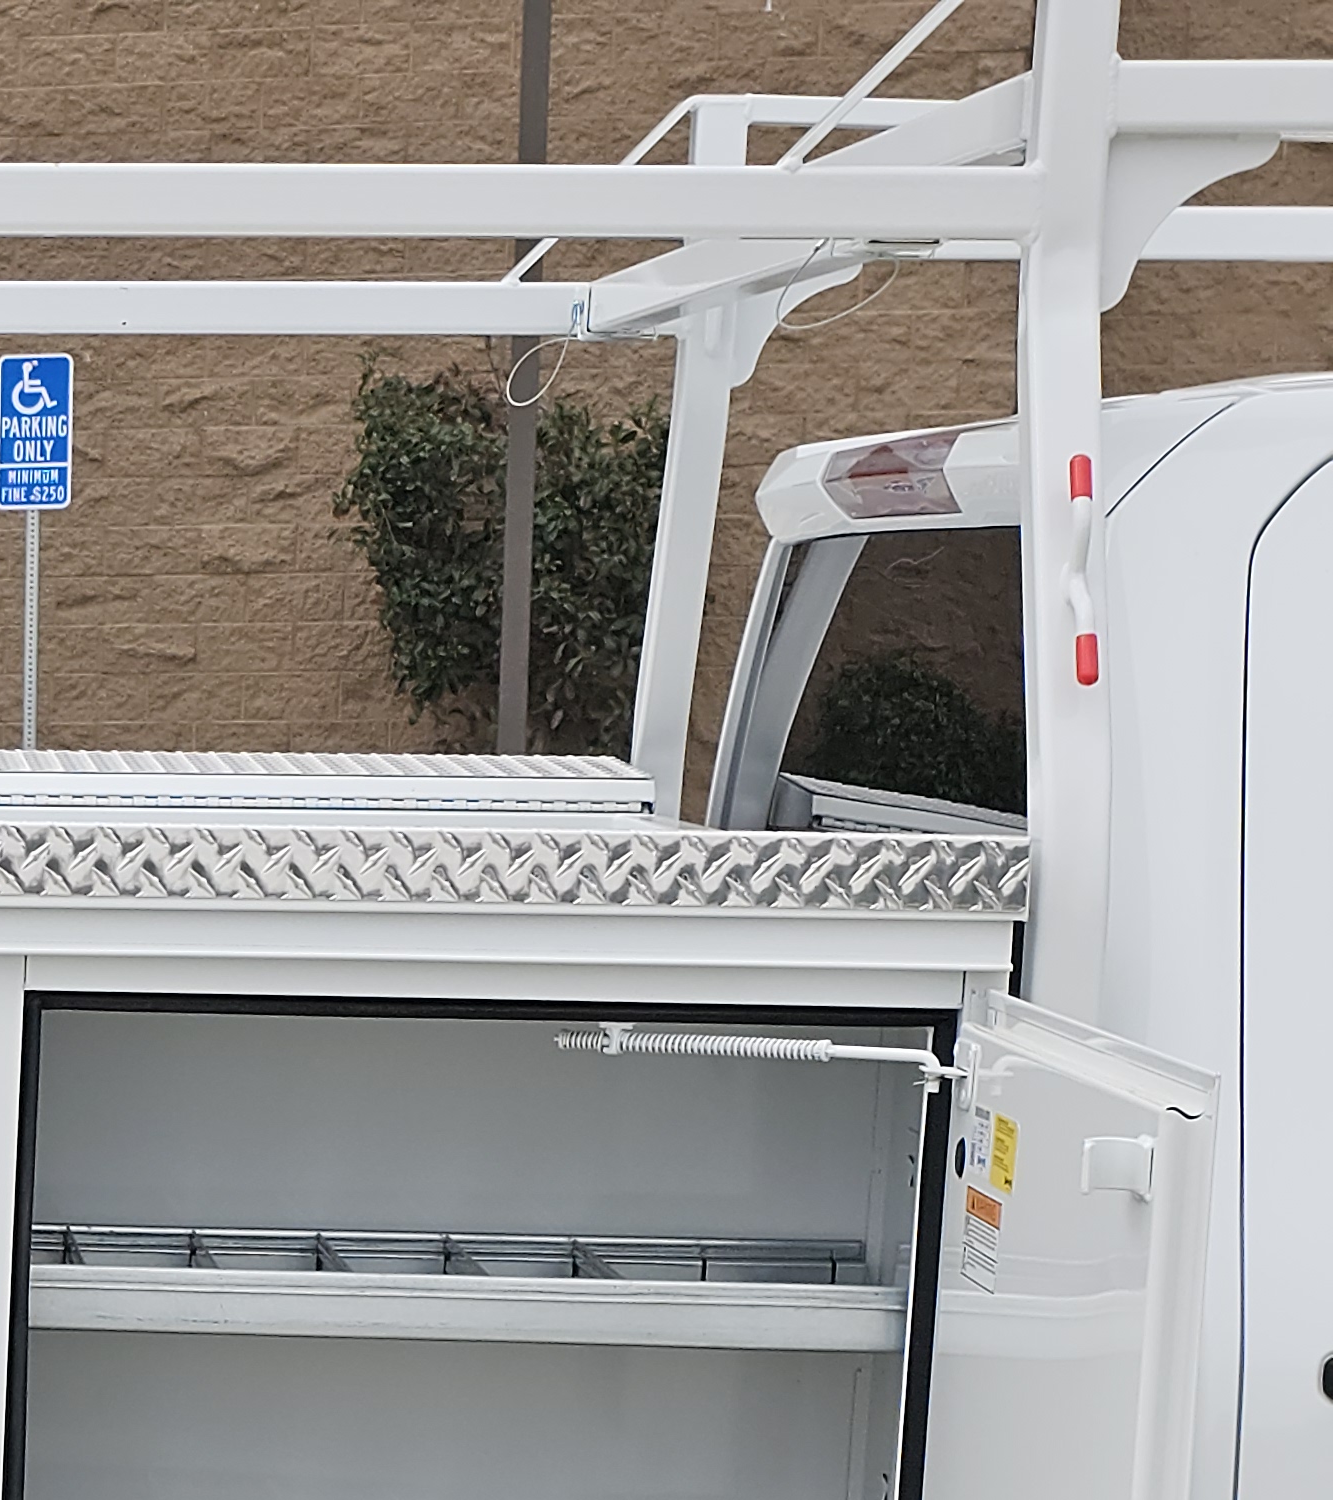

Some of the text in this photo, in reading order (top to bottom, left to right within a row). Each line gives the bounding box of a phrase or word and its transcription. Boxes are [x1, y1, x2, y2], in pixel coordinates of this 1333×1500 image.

[1, 415, 67, 438] PARKING
[14, 440, 54, 462] ONLY
[8, 469, 59, 485] MINIMUM
[1, 487, 28, 503] FINE
